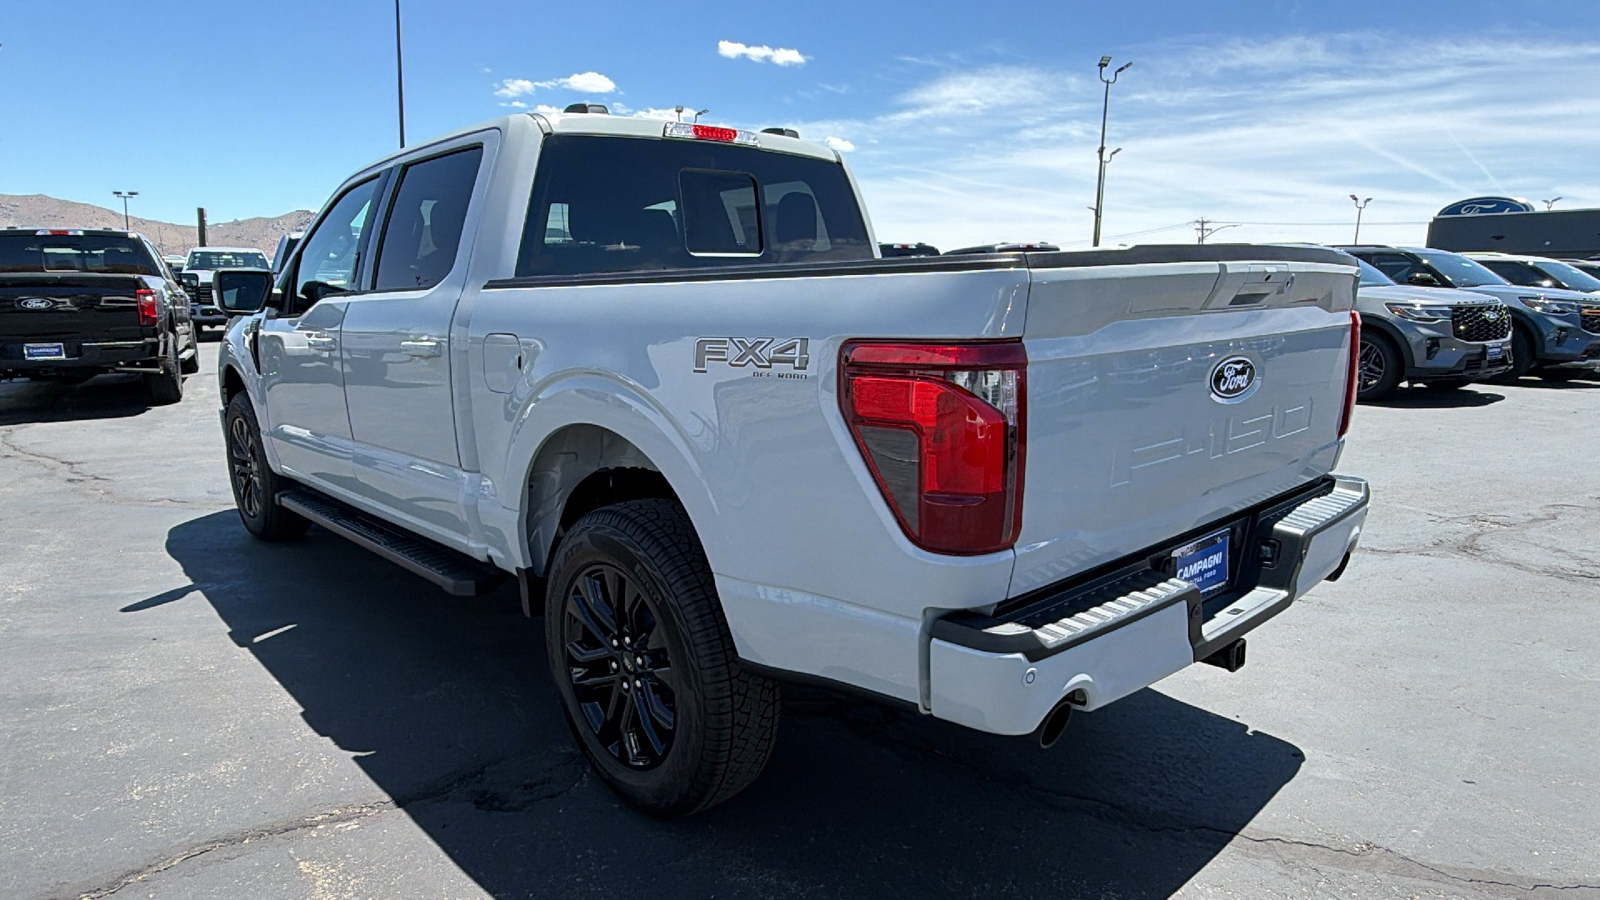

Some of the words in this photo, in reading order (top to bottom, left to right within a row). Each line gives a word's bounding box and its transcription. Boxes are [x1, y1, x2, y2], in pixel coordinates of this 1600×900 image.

[693, 336, 809, 373] FX4
[752, 371, 774, 379] OFF
[777, 372, 808, 380] ROAD
[1219, 363, 1250, 391] Ford
[1177, 551, 1222, 579] CAMPAGNI
[1203, 569, 1217, 580] FORD
